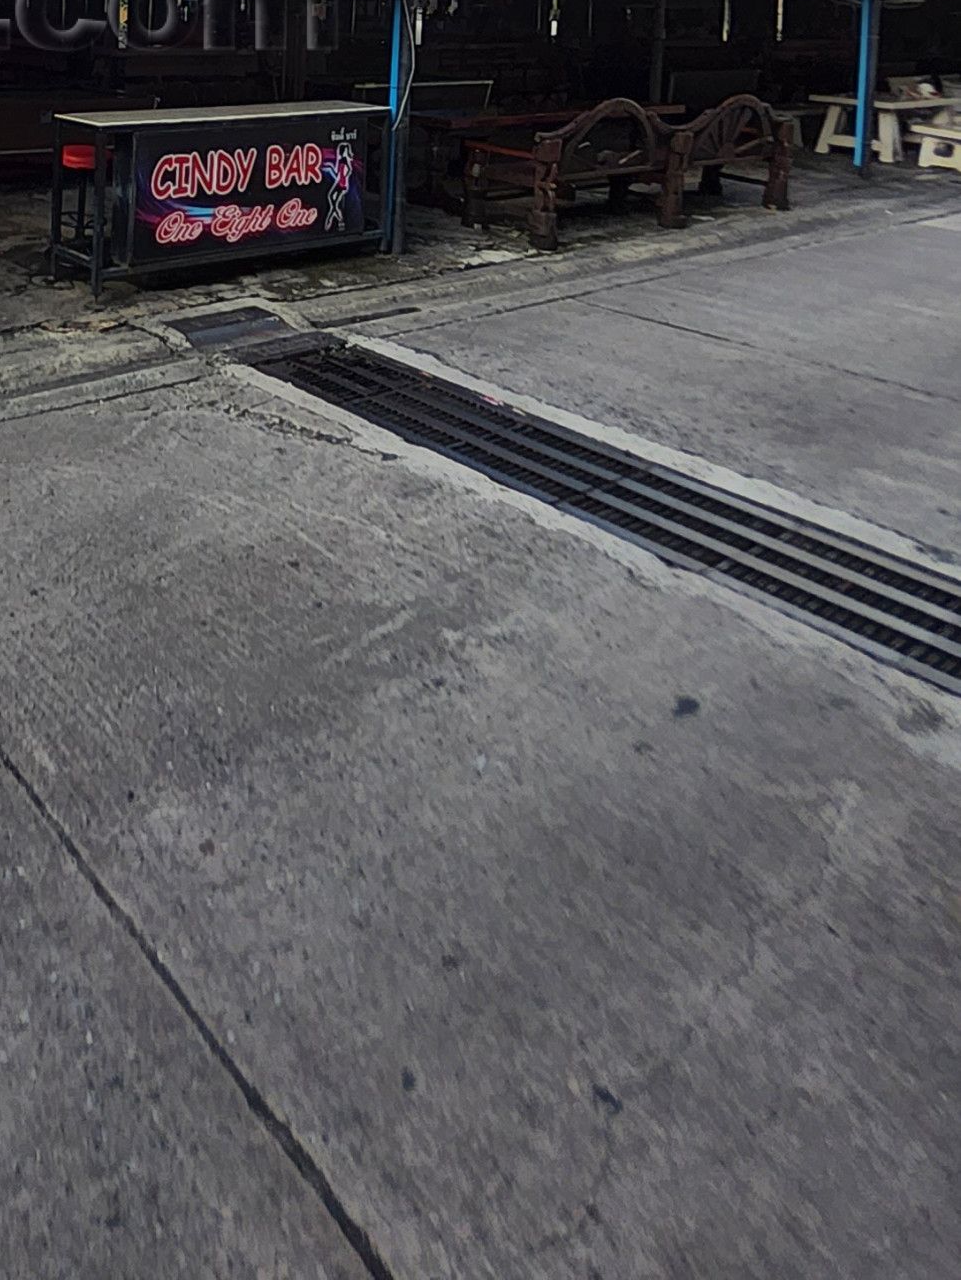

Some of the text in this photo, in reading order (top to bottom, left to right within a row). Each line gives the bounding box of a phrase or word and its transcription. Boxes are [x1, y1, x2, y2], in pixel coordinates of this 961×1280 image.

[151, 143, 322, 200] CINDY BAR
[156, 198, 318, 244] One Eight One
